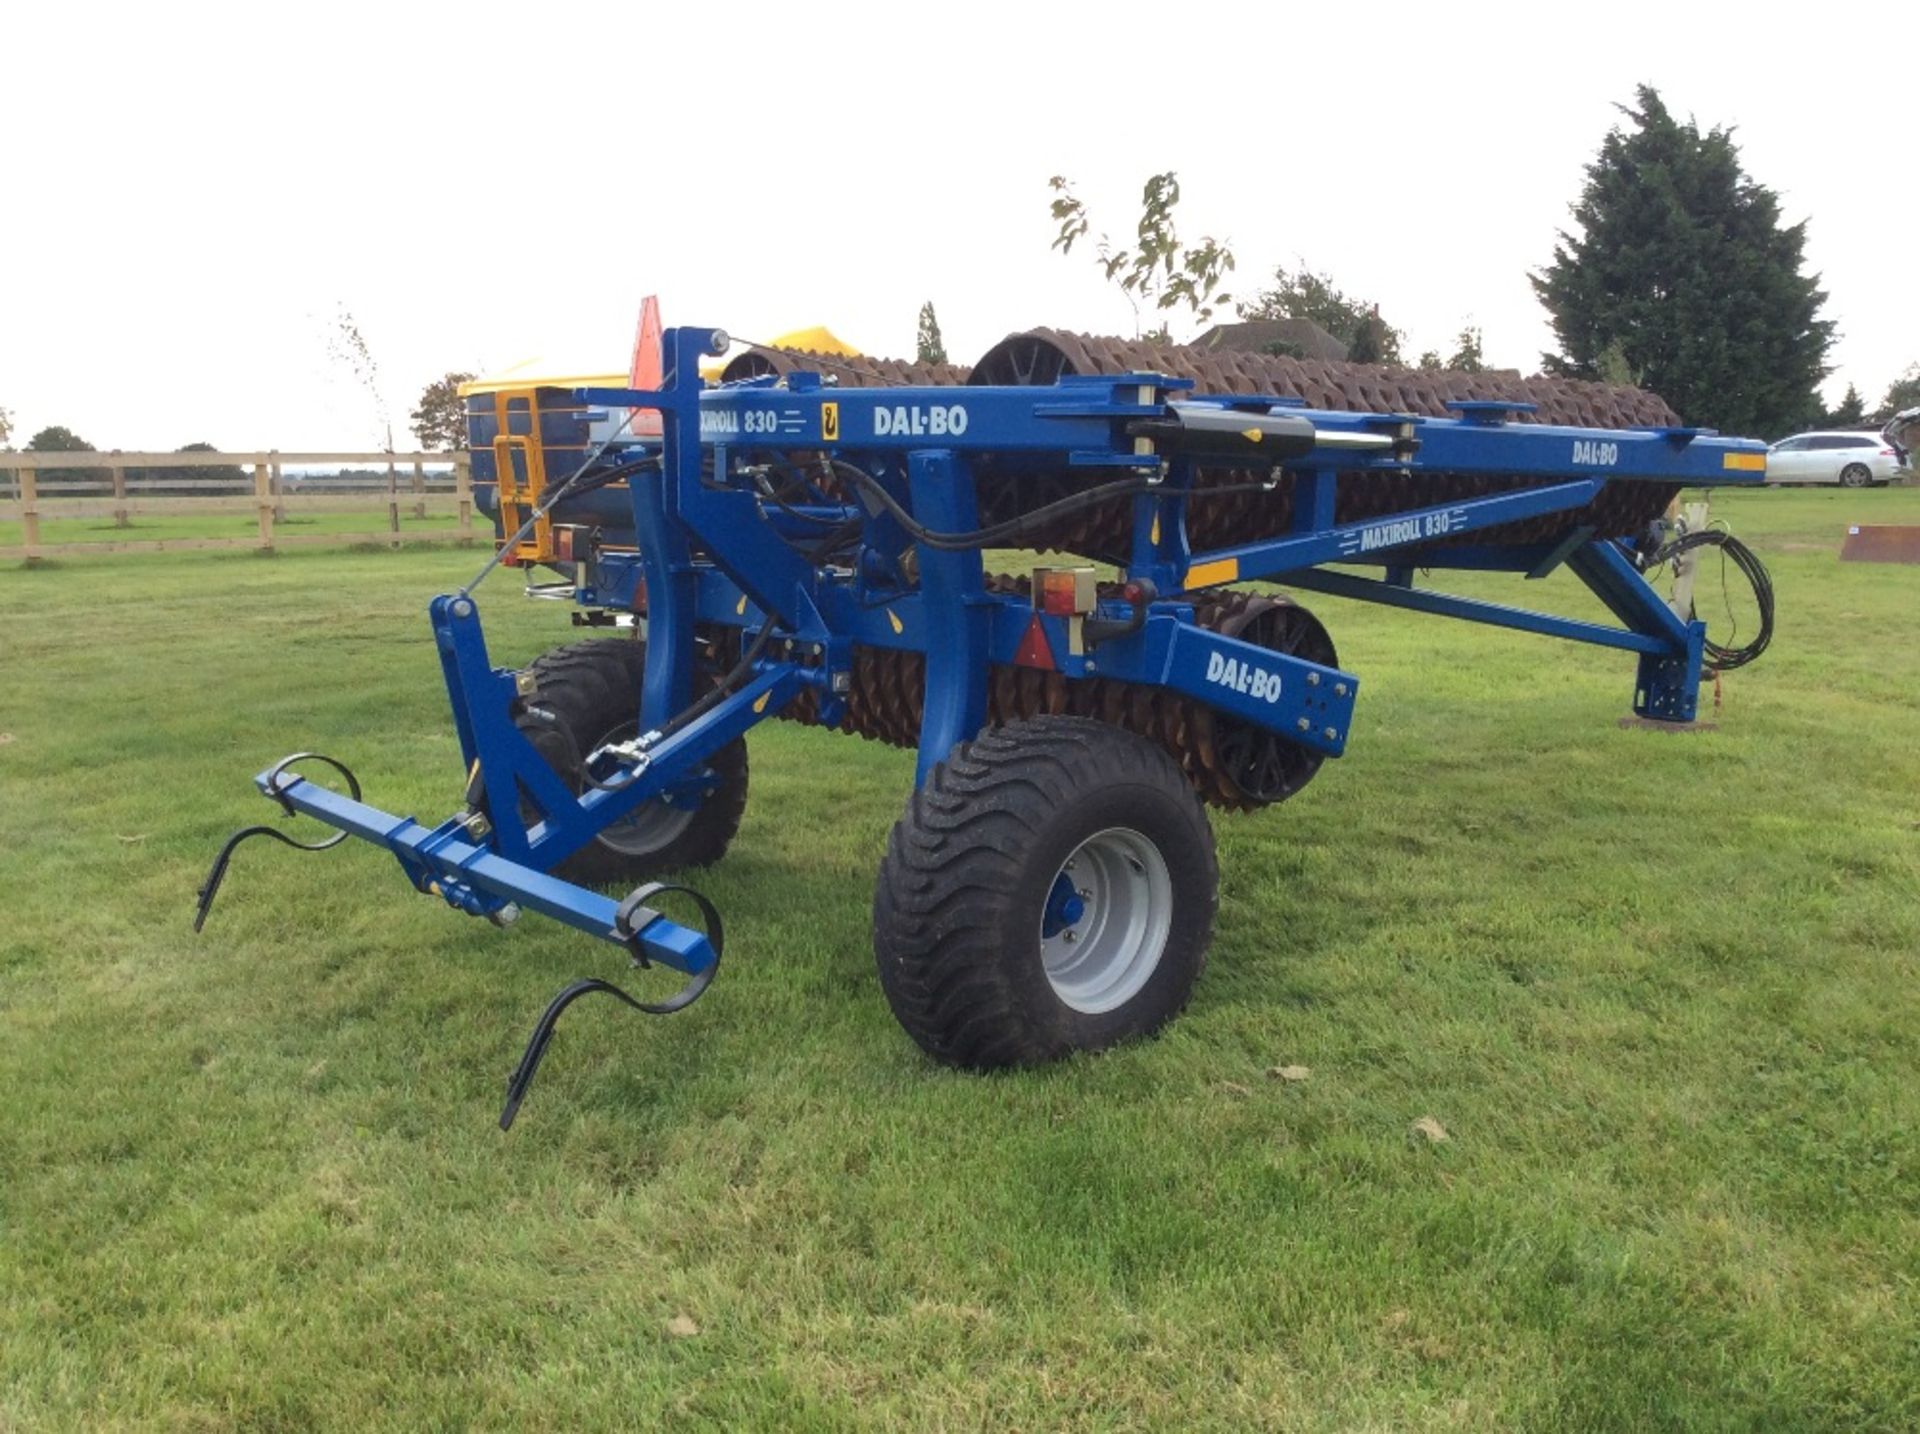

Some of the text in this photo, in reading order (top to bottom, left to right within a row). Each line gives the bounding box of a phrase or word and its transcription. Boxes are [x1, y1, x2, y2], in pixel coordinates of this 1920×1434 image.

[744, 410, 777, 433] 830
[1361, 512, 1450, 551] MAXIROLL 830
